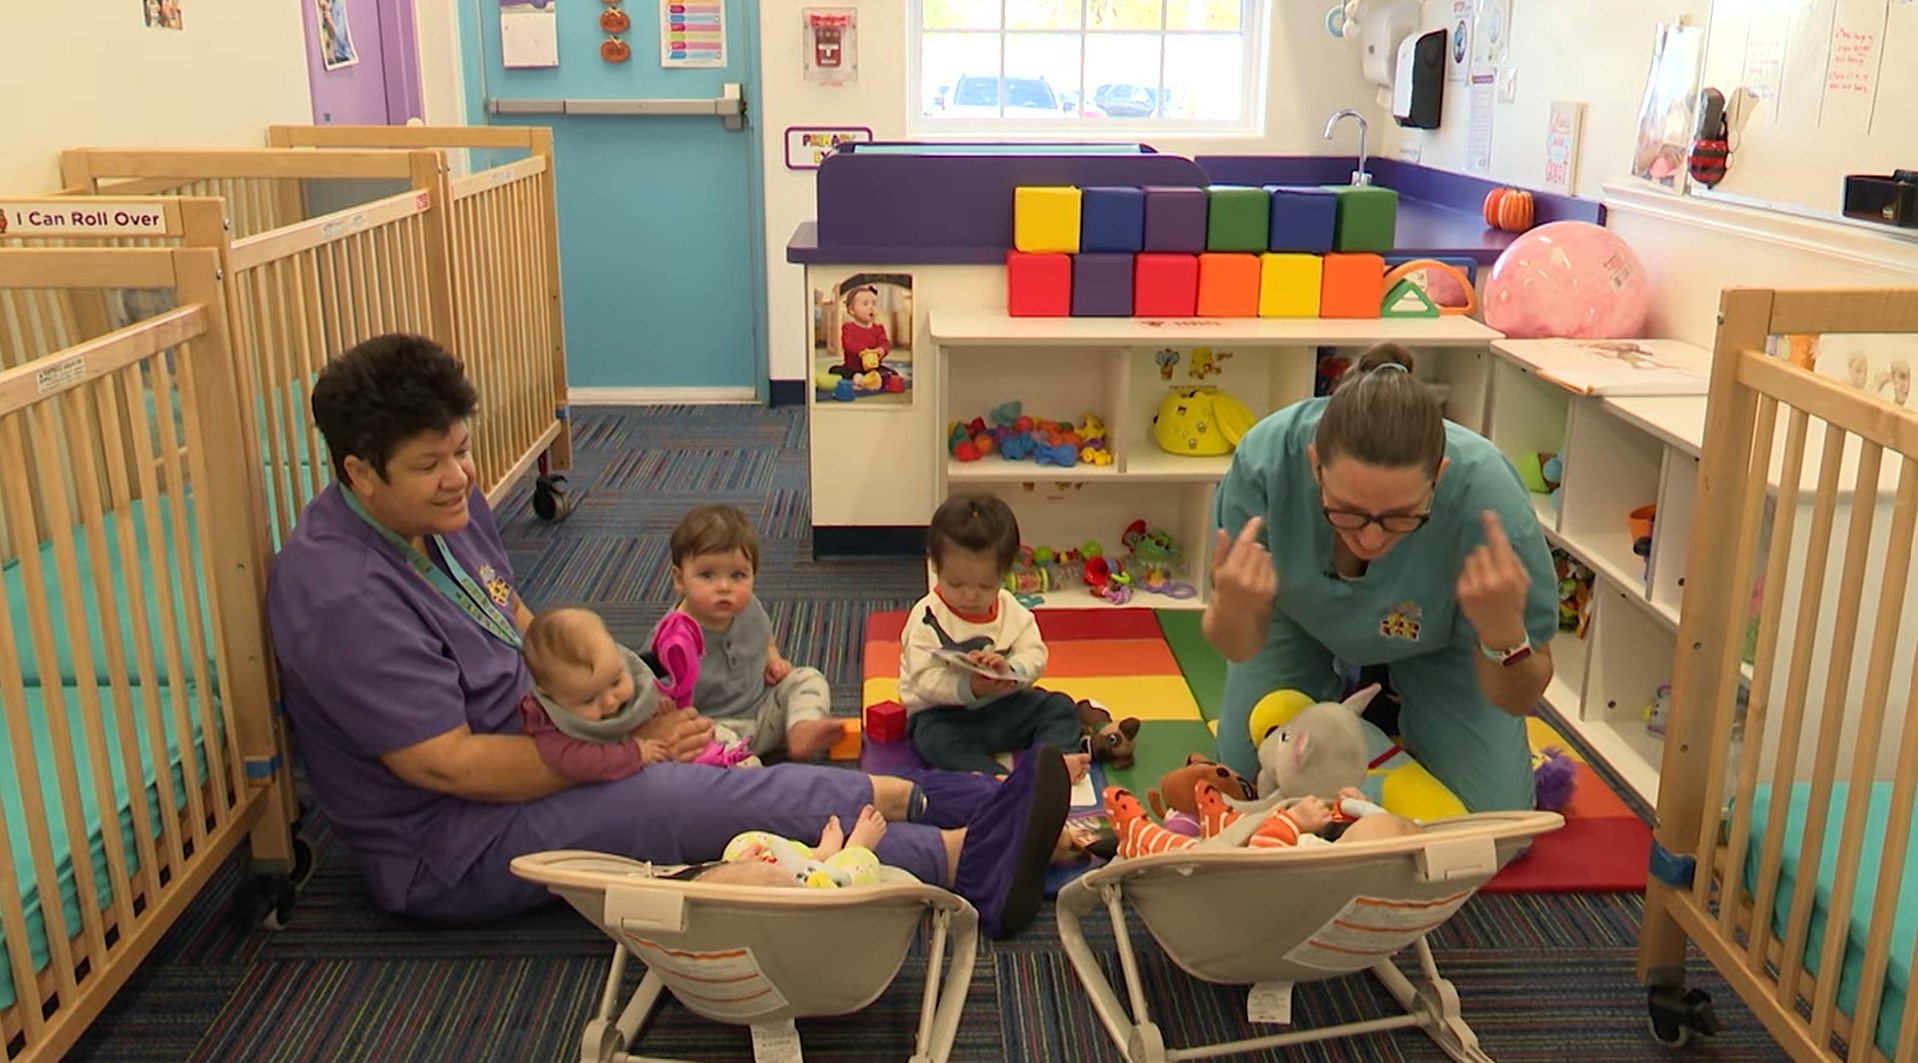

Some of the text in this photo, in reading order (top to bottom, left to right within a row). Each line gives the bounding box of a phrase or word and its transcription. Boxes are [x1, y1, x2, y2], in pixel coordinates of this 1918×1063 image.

[16, 211, 159, 226] I Can Roll Over
